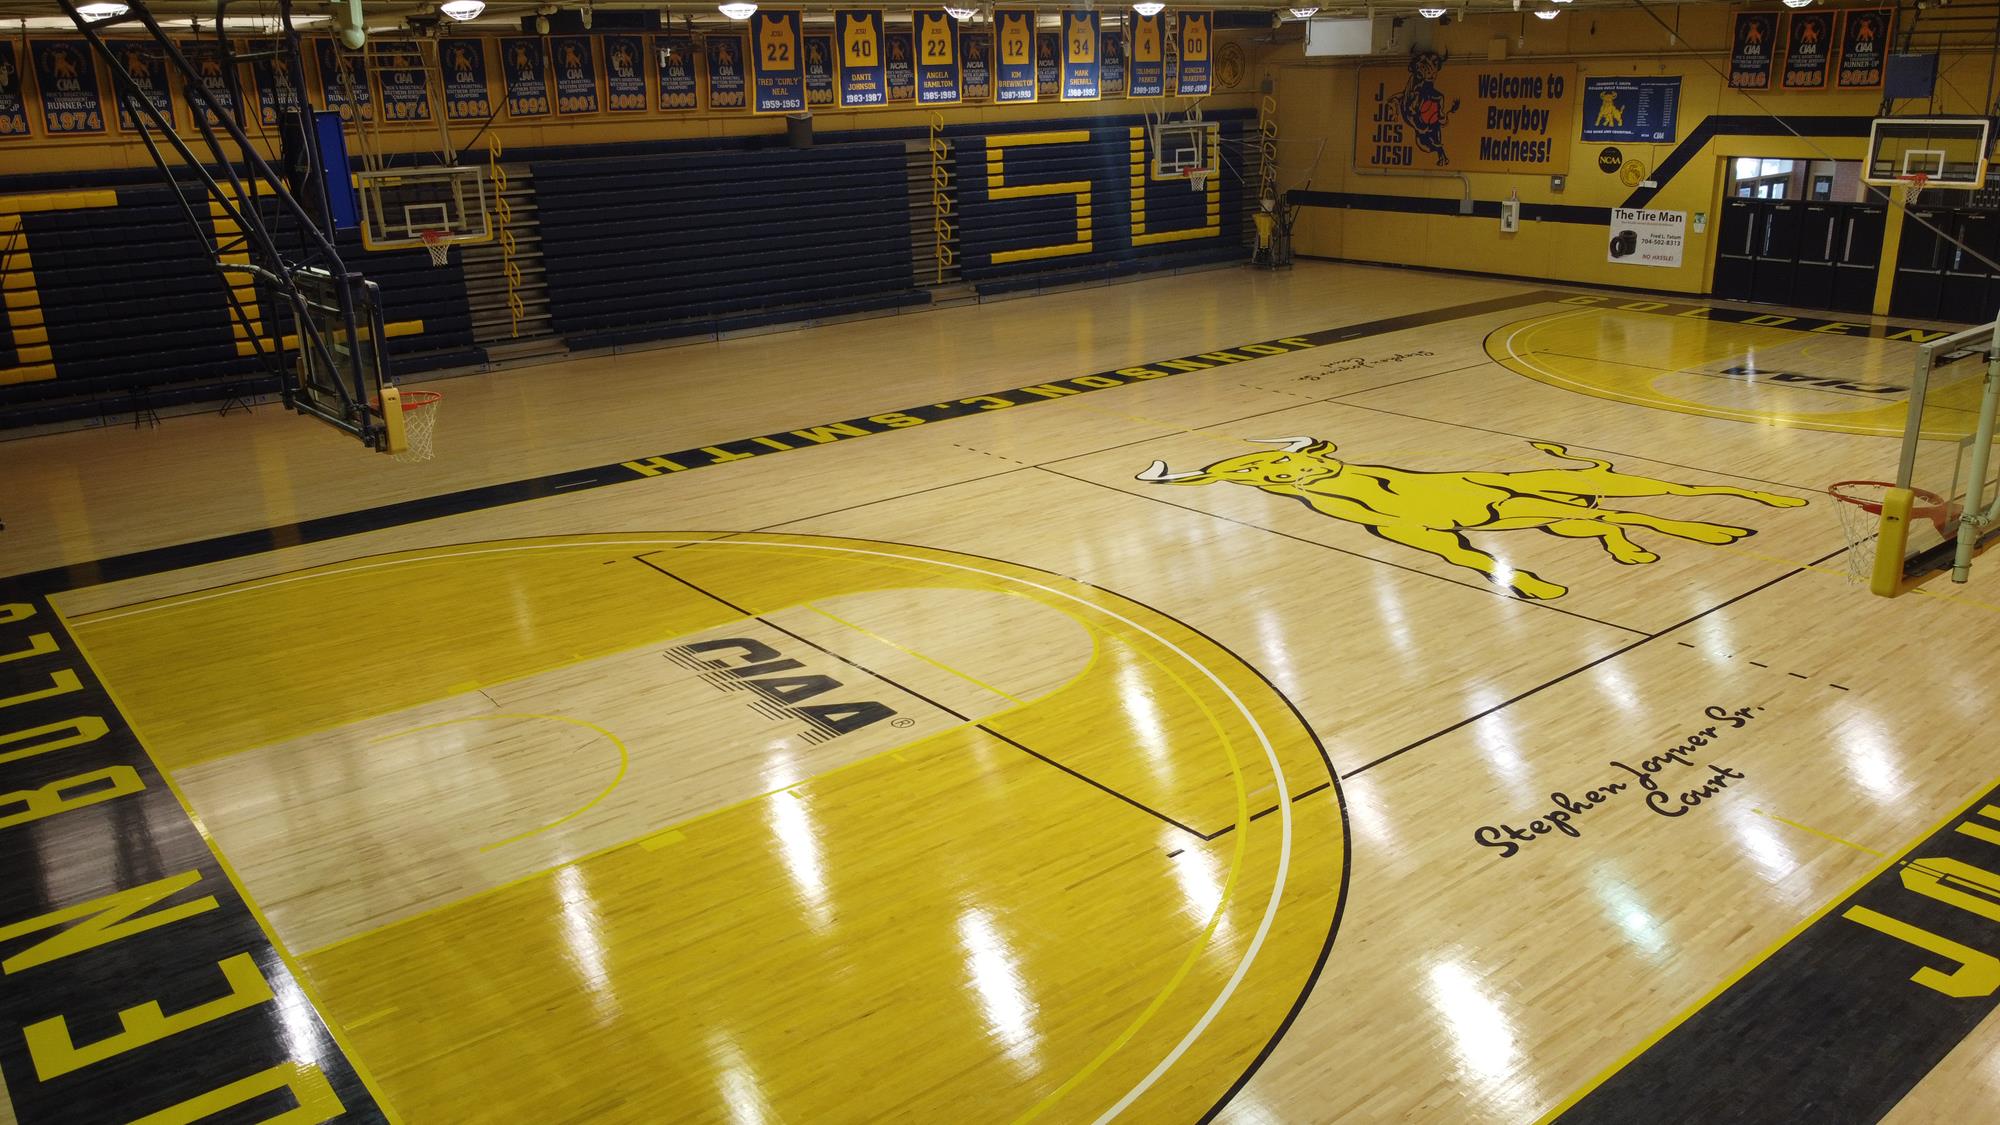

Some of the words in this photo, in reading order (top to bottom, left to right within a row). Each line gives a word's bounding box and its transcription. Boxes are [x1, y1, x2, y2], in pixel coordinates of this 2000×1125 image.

[767, 43, 789, 61] 22
[852, 40, 871, 57] 40
[927, 40, 946, 56] 22
[1008, 40, 1023, 56] 12
[1073, 40, 1088, 55] 34
[1144, 40, 1151, 55] 4
[1188, 39, 1202, 53] 00
[852, 73, 871, 81] DANTE
[1478, 73, 1542, 99] Welcome
[1548, 74, 1564, 99] to
[772, 88, 788, 96] NEAL
[848, 82, 876, 91] JOHNSON
[1375, 83, 1384, 101] J
[48, 102, 97, 110] RUNNER-UP
[762, 100, 800, 109] 1959-1963
[48, 112, 100, 131] 1974
[1487, 106, 1549, 135] Brayboy
[1373, 124, 1403, 143] JCS
[1371, 145, 1413, 166] JCSU
[1480, 137, 1552, 162] Madness!
[1615, 210, 1634, 220] The
[1636, 211, 1656, 221] Tire
[1659, 212, 1682, 223] Man
[1556, 295, 1955, 343] GOLDEN
[1018, 337, 1318, 398] JOHNSON
[619, 411, 927, 477] SMITH
[664, 637, 898, 745] CIAA
[1474, 781, 1627, 858] Stephen
[1609, 726, 1719, 790] Joyner
[1704, 705, 1766, 728] Sr.
[1646, 764, 1745, 817] Court
